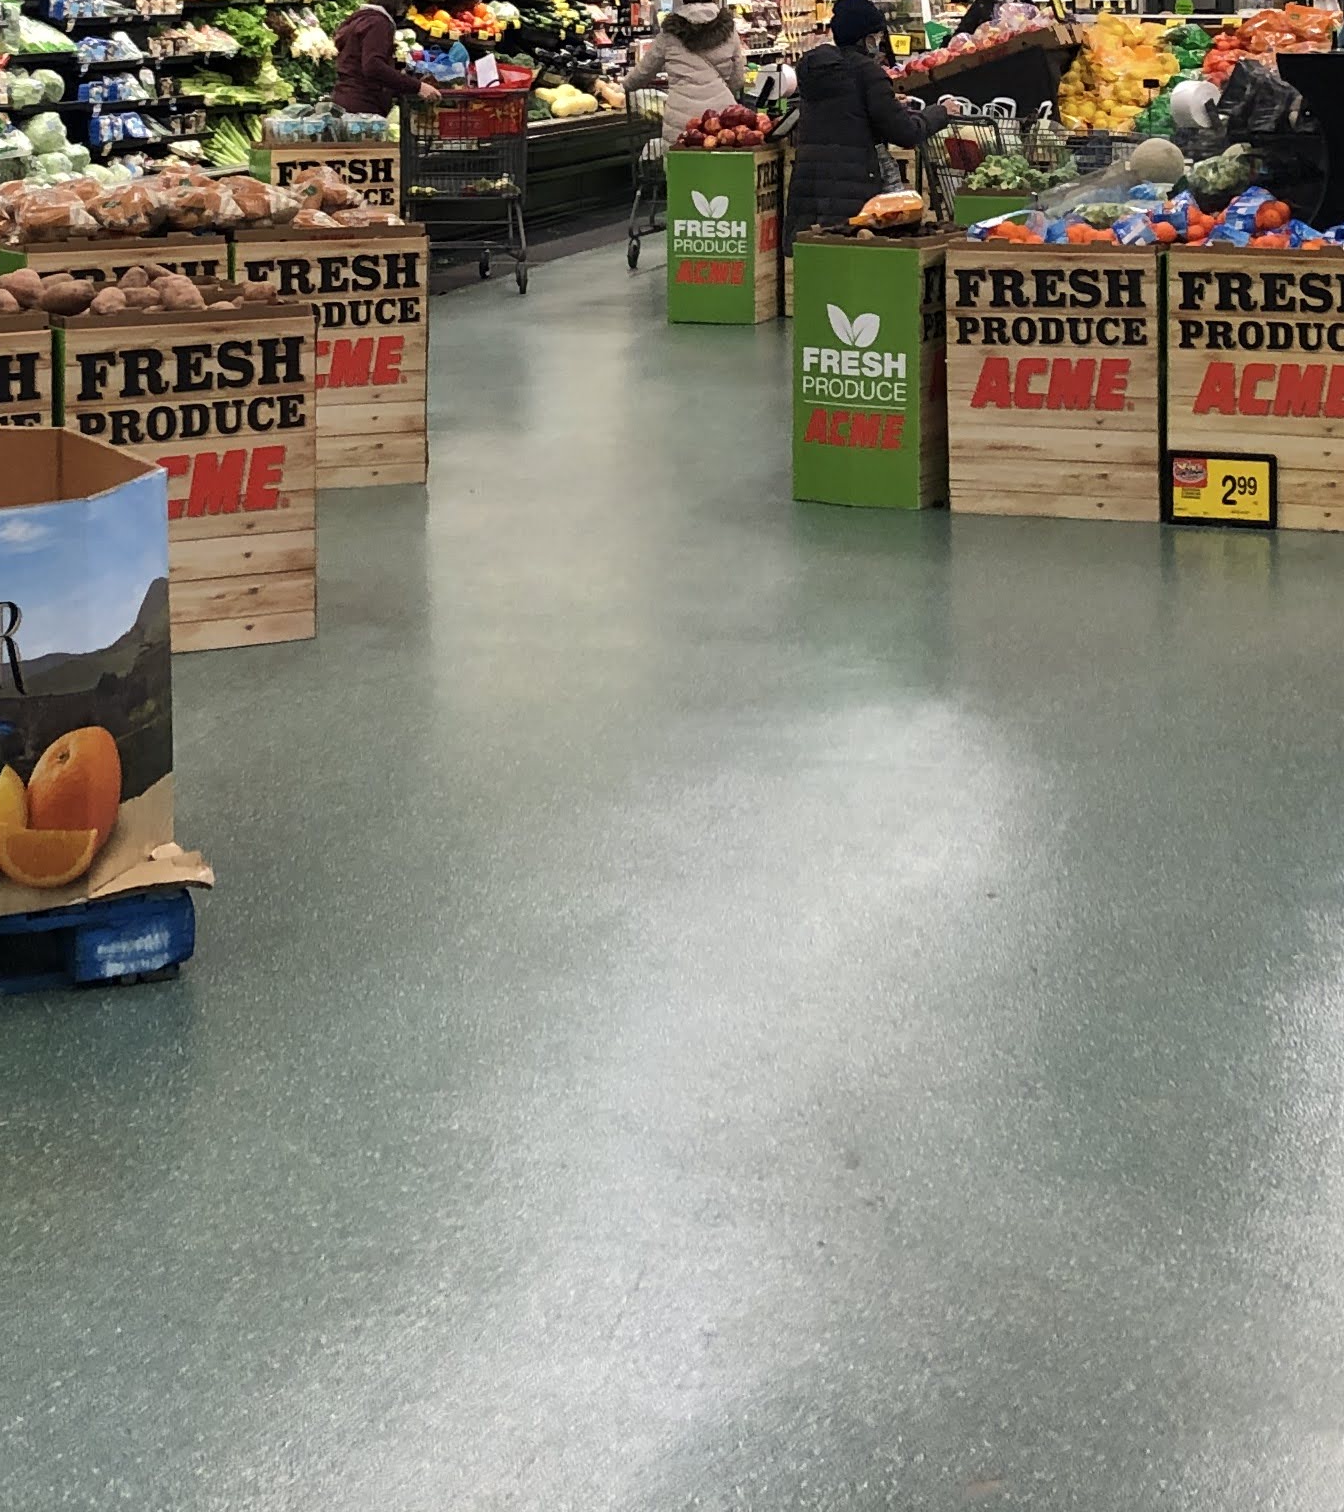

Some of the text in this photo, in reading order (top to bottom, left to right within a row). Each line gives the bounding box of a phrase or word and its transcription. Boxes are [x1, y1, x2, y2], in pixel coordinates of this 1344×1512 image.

[673, 219, 747, 238] FRESH
[673, 239, 747, 253] PRODUCE
[676, 261, 745, 285] ACME
[954, 269, 1146, 308] FRESH
[315, 297, 420, 328] DUCE
[955, 316, 1147, 345] PRODUCE
[76, 336, 305, 401] FRESH
[803, 347, 906, 379] FRESH
[802, 375, 906, 402] PRODUCE
[970, 357, 1132, 411] ACME
[77, 394, 306, 444] PRODUCE
[804, 408, 905, 449] ACME
